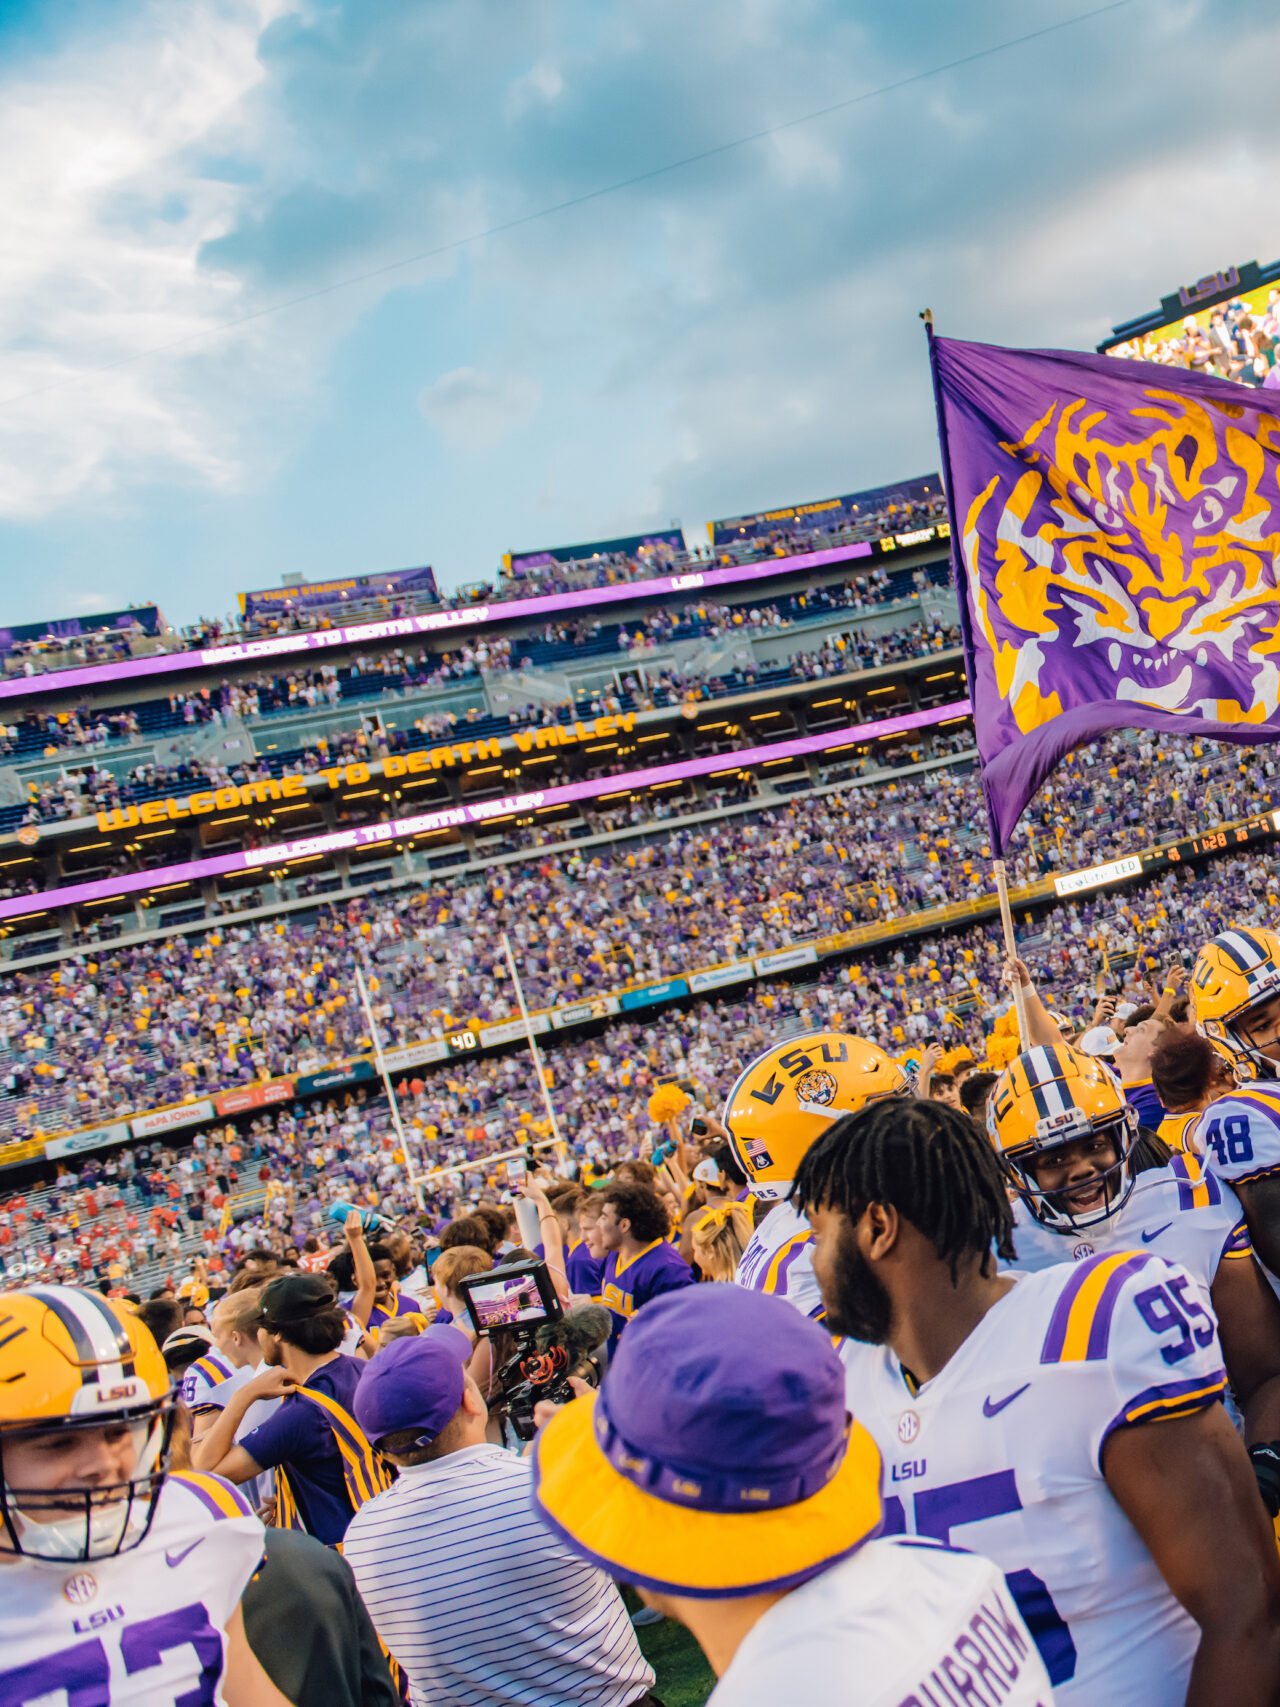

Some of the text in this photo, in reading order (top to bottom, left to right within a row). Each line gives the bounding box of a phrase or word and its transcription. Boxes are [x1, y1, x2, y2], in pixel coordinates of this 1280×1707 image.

[1179, 266, 1241, 308] LSU
[96, 711, 637, 833] WELCOME TO DEATH VALLEY
[451, 1032, 477, 1050] 40
[144, 1116, 169, 1129] PAPA
[1046, 1112, 1074, 1130] LSU
[1206, 1114, 1254, 1166] 48
[602, 1281, 635, 1318] SU
[1133, 1274, 1215, 1366] 95
[96, 1383, 137, 1402] LSU
[892, 1459, 927, 1483] LSU
[72, 1604, 126, 1634] LSU
